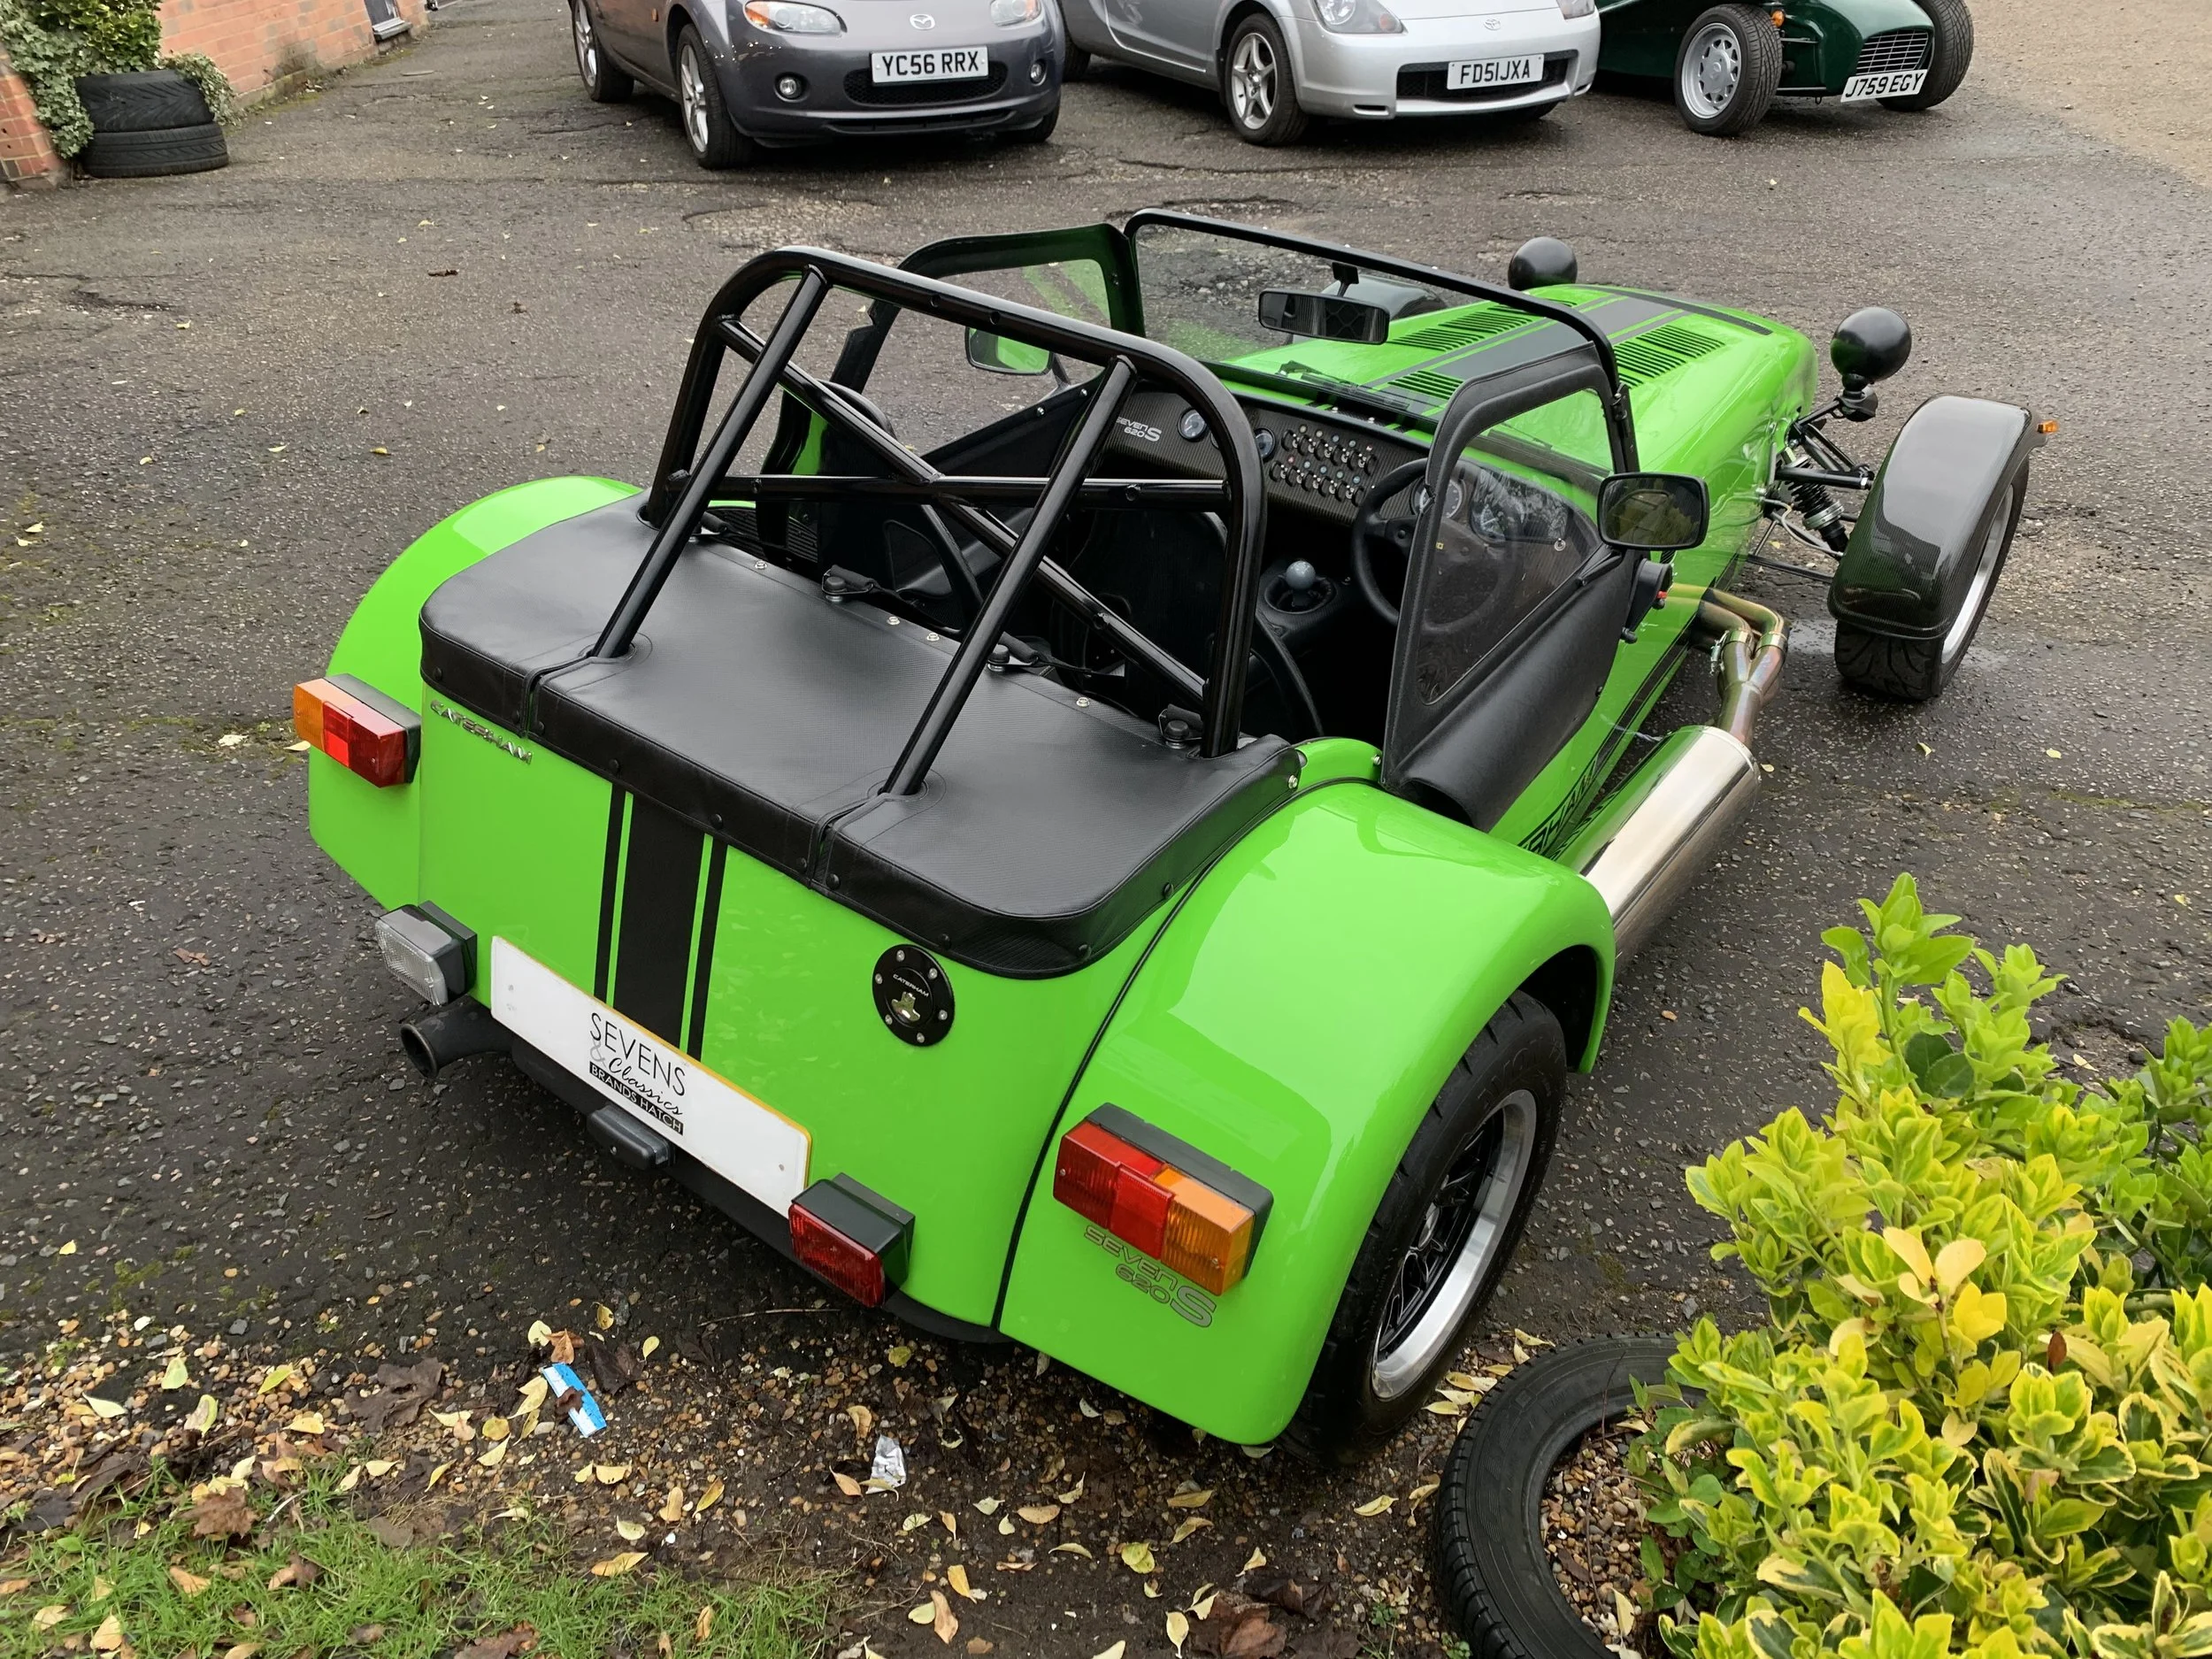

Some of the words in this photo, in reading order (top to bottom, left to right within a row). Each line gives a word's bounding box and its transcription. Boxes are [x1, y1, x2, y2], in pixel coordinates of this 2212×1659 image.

[882, 54, 935, 76] YC56
[941, 51, 979, 73] RRX
[1845, 76, 1889, 97] J759
[1889, 73, 1924, 93] EGY
[430, 700, 533, 765] CATERHAM
[893, 974, 929, 997] CATERHAM
[590, 1012, 686, 1096] SEVENS
[591, 1064, 638, 1103] BRANDS
[640, 1097, 682, 1134] HATCH
[609, 1057, 683, 1116] Classics
[1084, 1225, 1178, 1292] SEVEN
